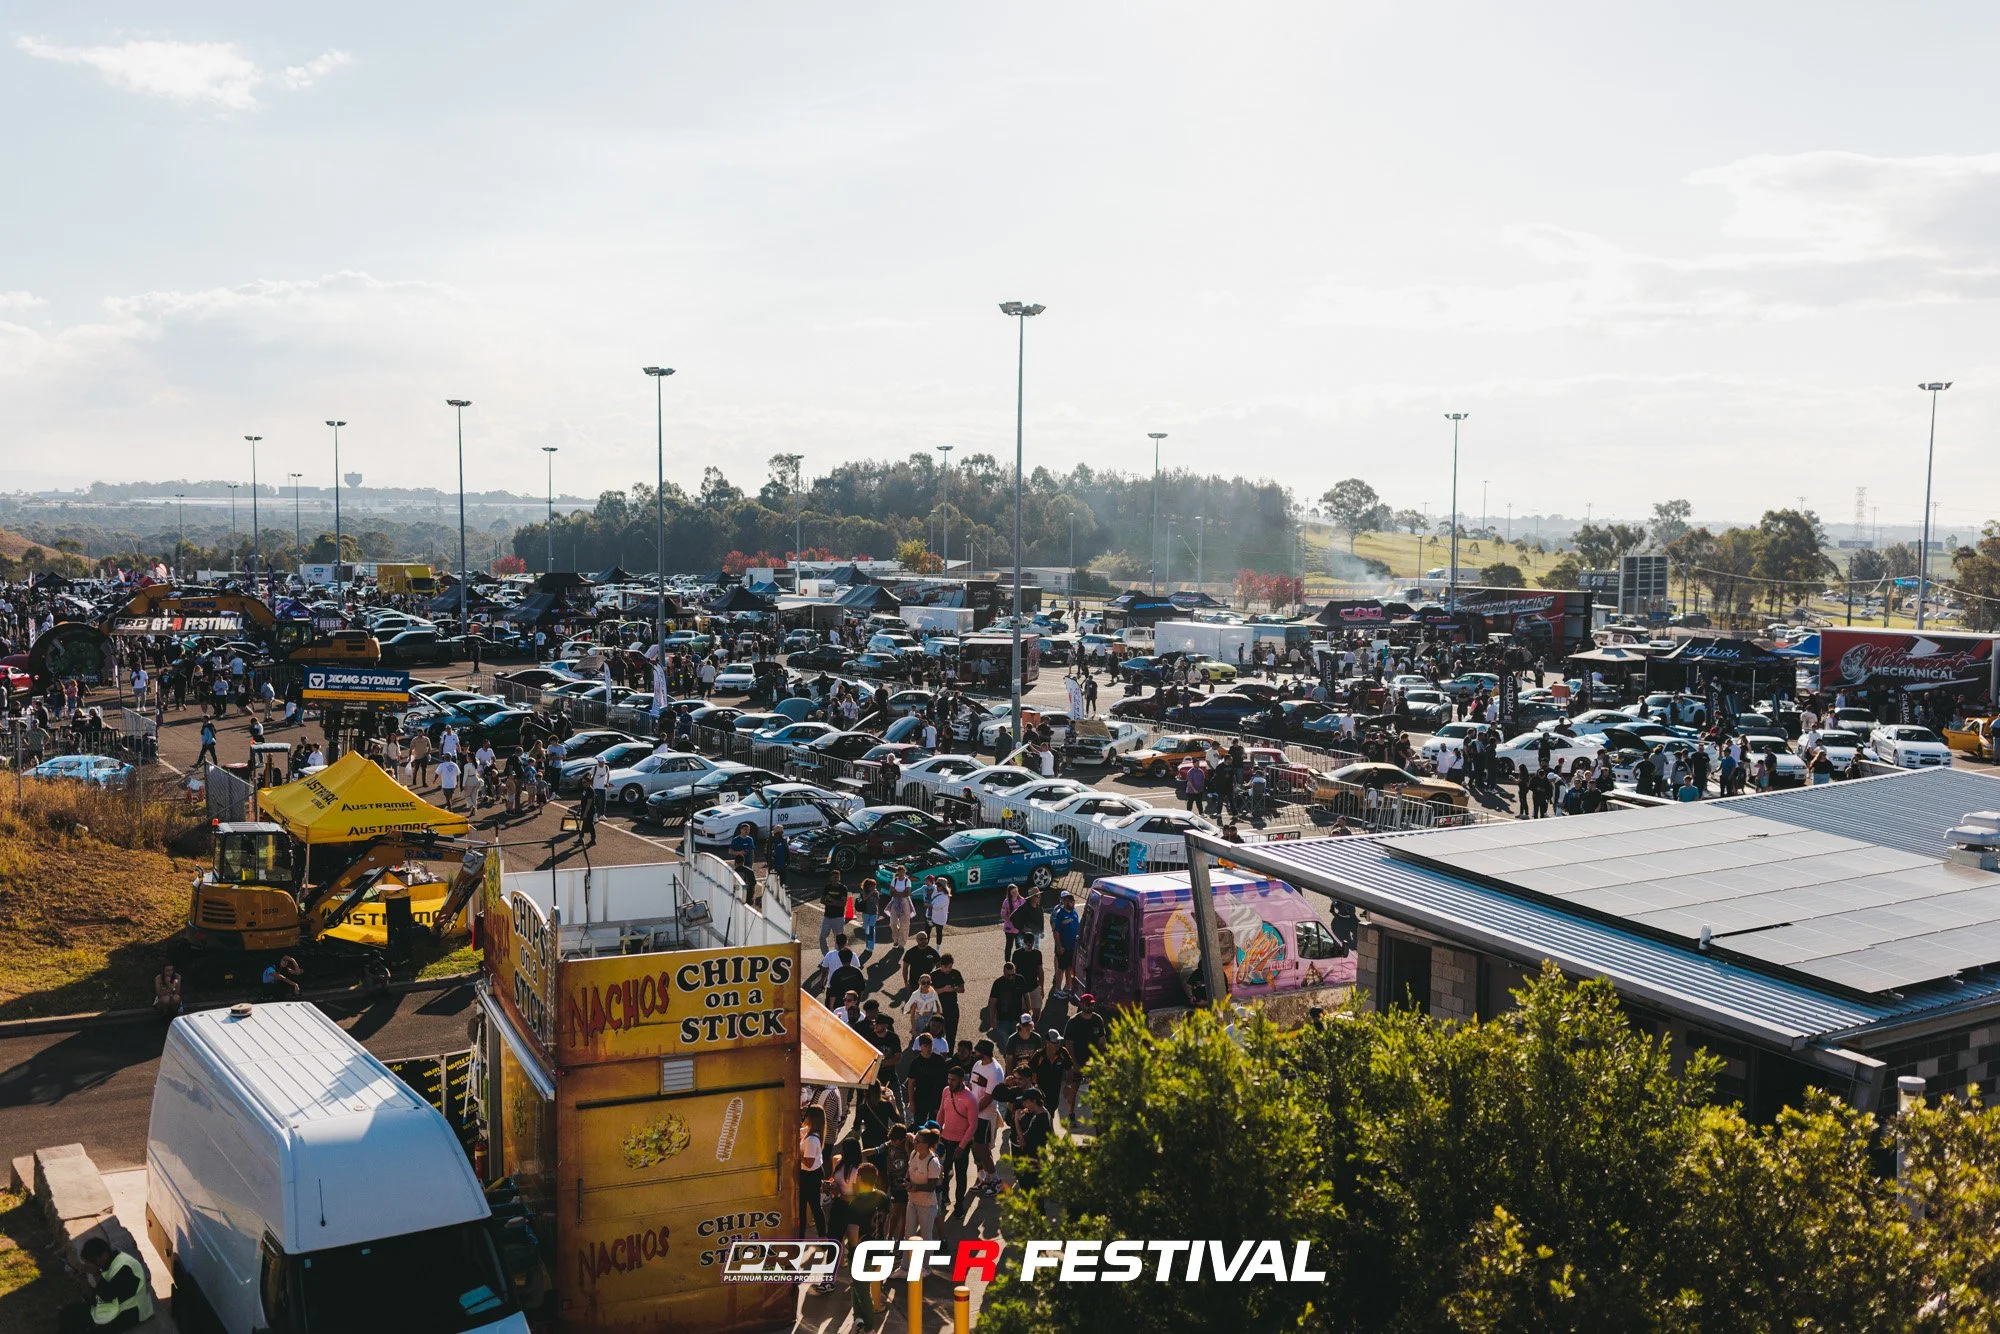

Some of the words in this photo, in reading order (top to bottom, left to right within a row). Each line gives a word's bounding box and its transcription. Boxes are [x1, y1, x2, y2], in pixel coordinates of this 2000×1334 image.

[151, 618, 182, 630] GT-R
[184, 617, 243, 630] FESTIVAL
[327, 674, 360, 684] XCMG
[360, 675, 404, 685] SYDNEY
[1872, 666, 1957, 681] MECHANICAL
[341, 801, 416, 812] AUSTRAMAC
[725, 794, 736, 802] 20
[777, 813, 789, 822] 109
[969, 870, 979, 883] 3
[512, 895, 547, 969] CHIPS
[520, 944, 531, 976] on
[532, 960, 538, 985] a
[676, 955, 793, 992] CHIPS
[514, 968, 545, 1046] STICK
[568, 971, 670, 1048] NACHOS
[705, 991, 740, 1009] on
[748, 988, 763, 1006] a
[680, 1008, 787, 1045] STICK
[696, 1211, 781, 1237] CHIPS
[578, 1226, 670, 1288] NACHOS
